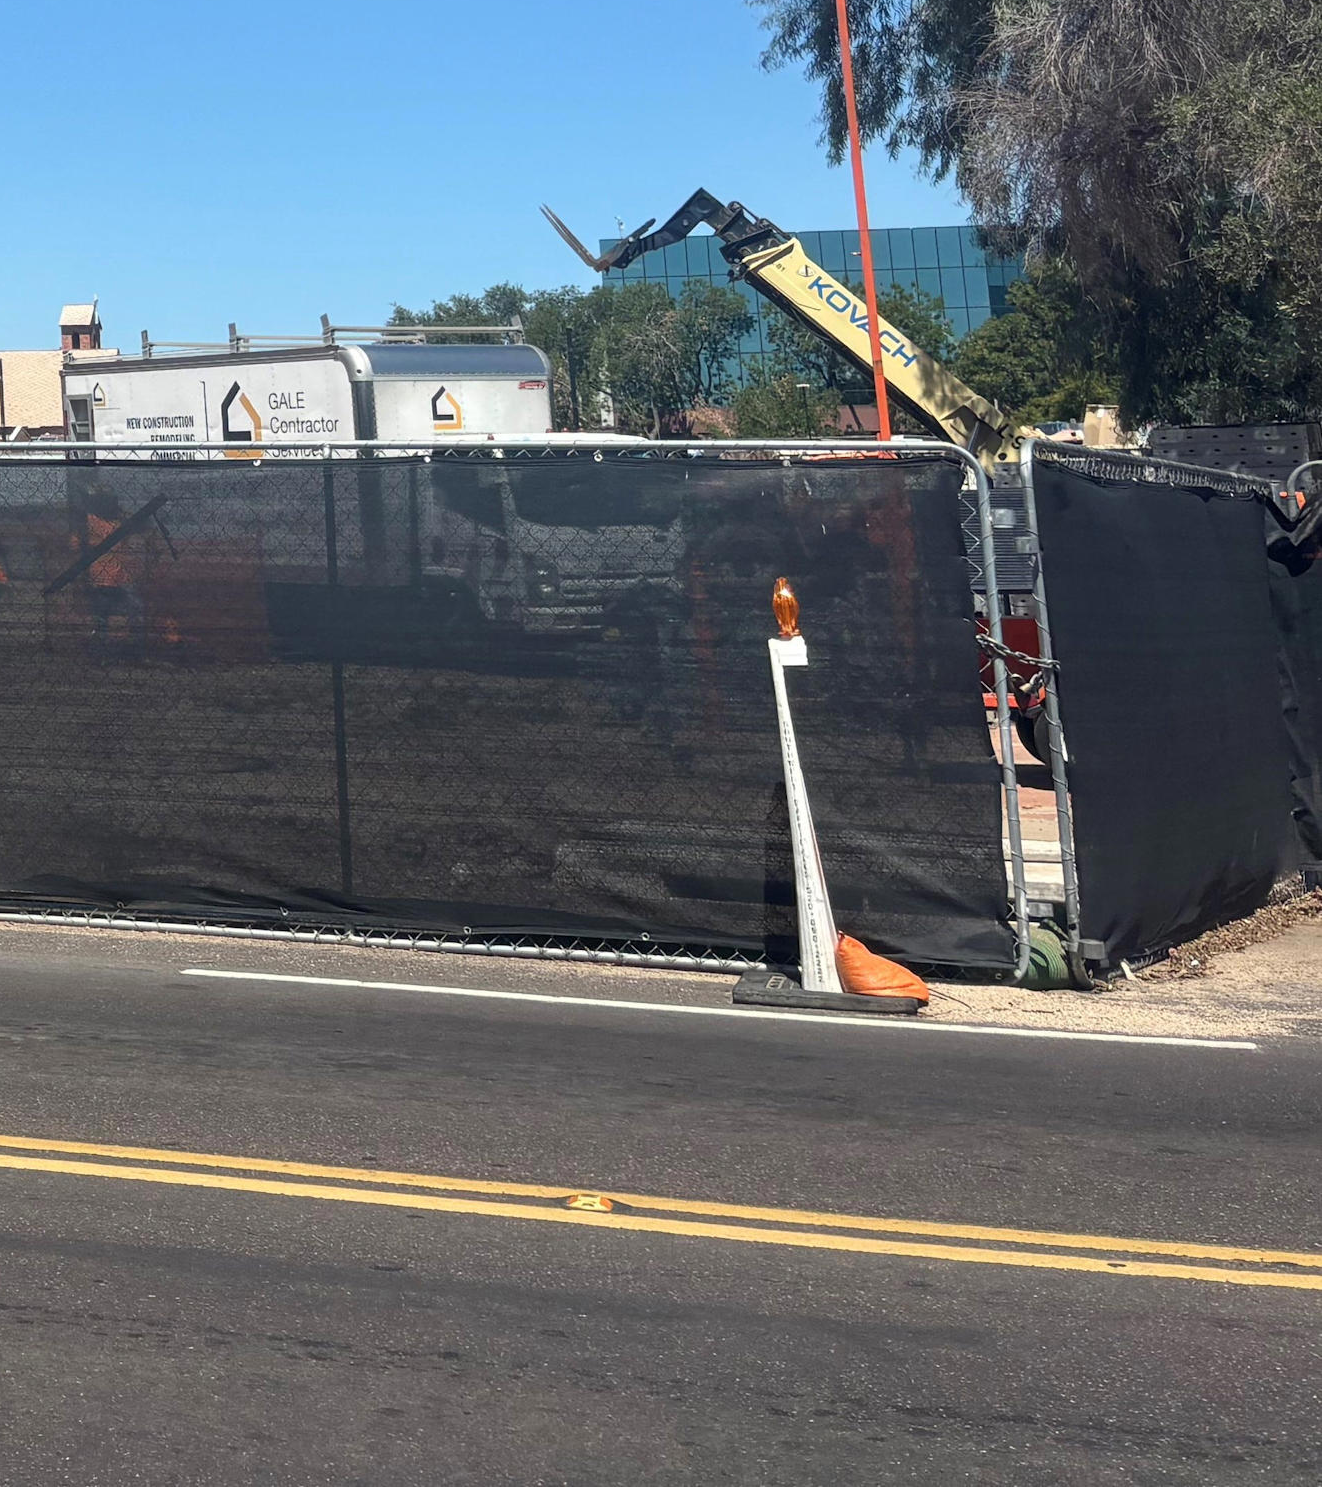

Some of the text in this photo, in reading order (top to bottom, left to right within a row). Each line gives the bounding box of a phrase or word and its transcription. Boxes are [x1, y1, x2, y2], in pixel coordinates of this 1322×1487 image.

[268, 391, 306, 410] GALE
[126, 415, 194, 429] NEW CONSTRUCTION
[270, 416, 339, 434] Contractor
